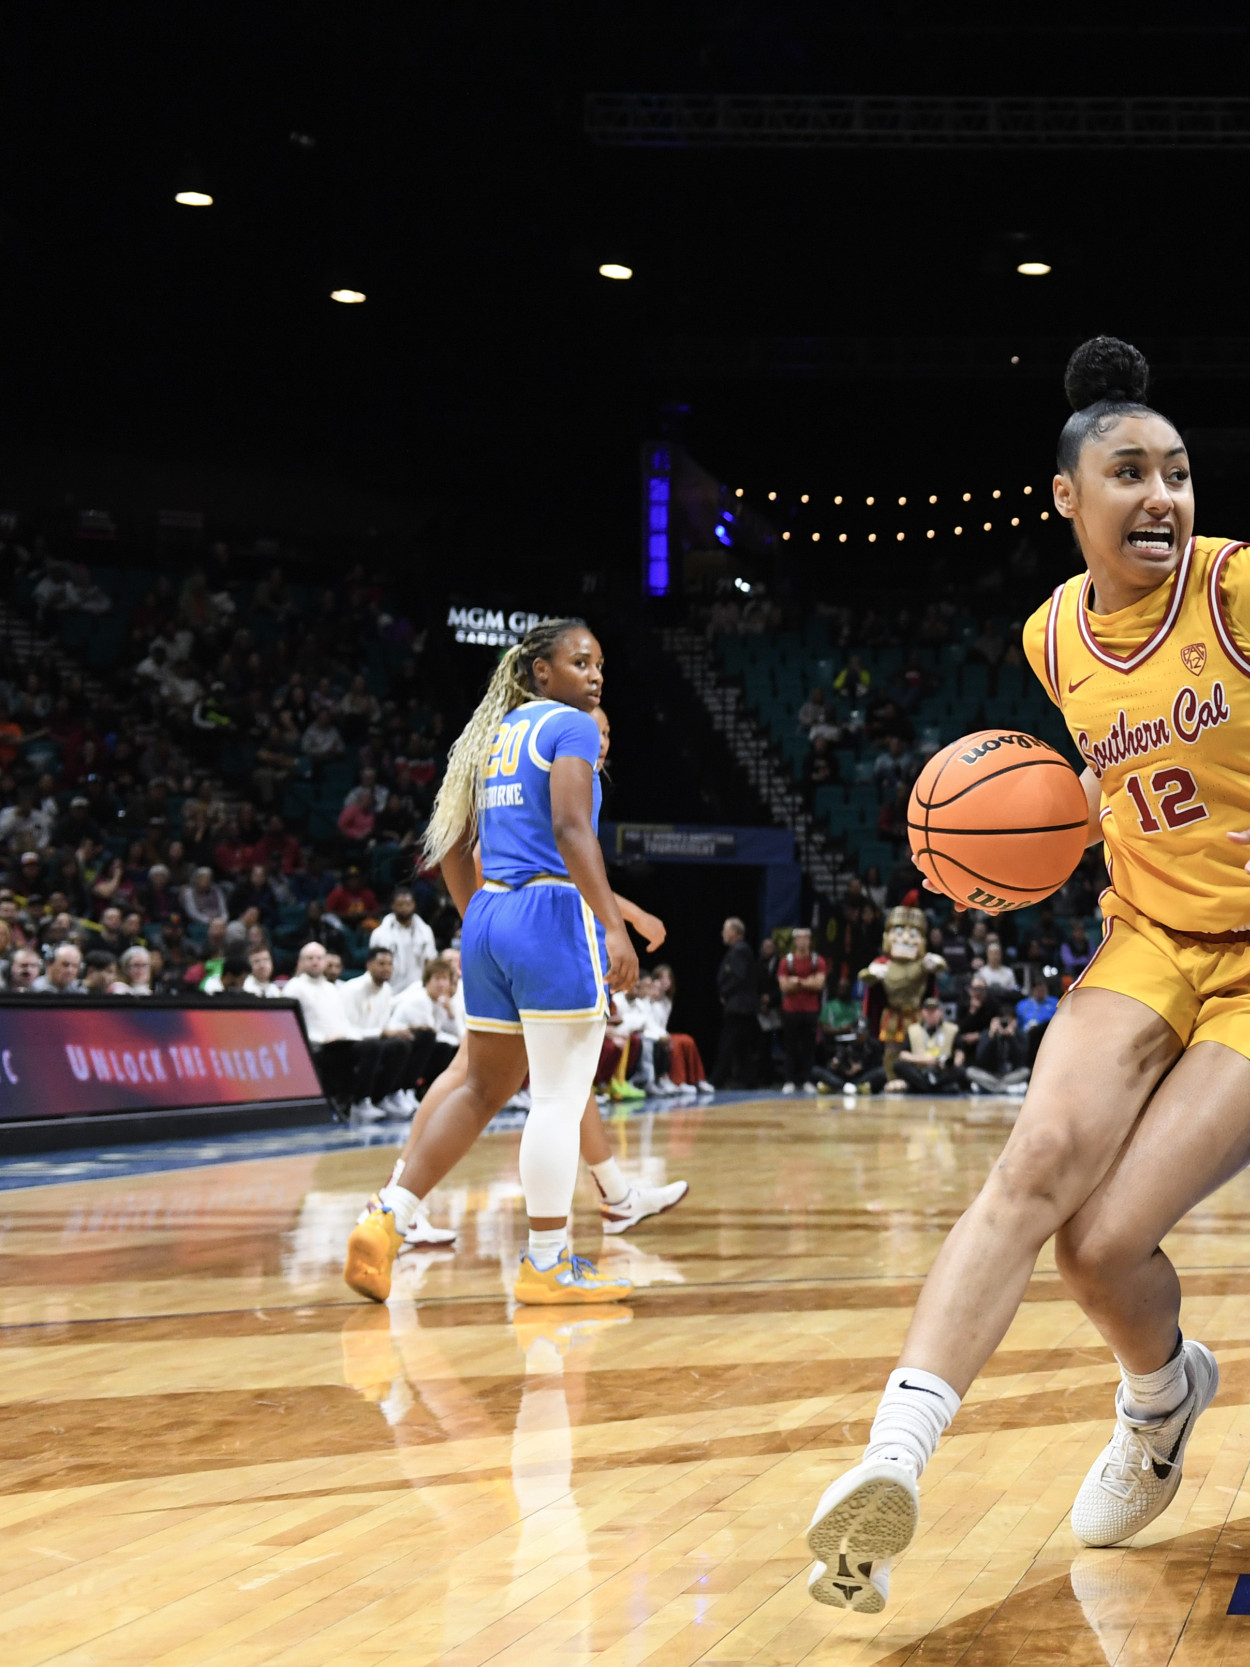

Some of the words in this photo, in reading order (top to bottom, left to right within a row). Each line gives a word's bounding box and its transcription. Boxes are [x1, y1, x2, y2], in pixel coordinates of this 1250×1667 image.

[447, 606, 505, 631] MGM
[455, 630, 518, 646] GARDEN
[1078, 709, 1170, 779] Southern
[1171, 681, 1230, 743] Cal
[1125, 766, 1210, 834] 12
[65, 1044, 168, 1084] UNLOCK
[168, 1044, 207, 1080] THE
[208, 1040, 290, 1081] ENERGY
